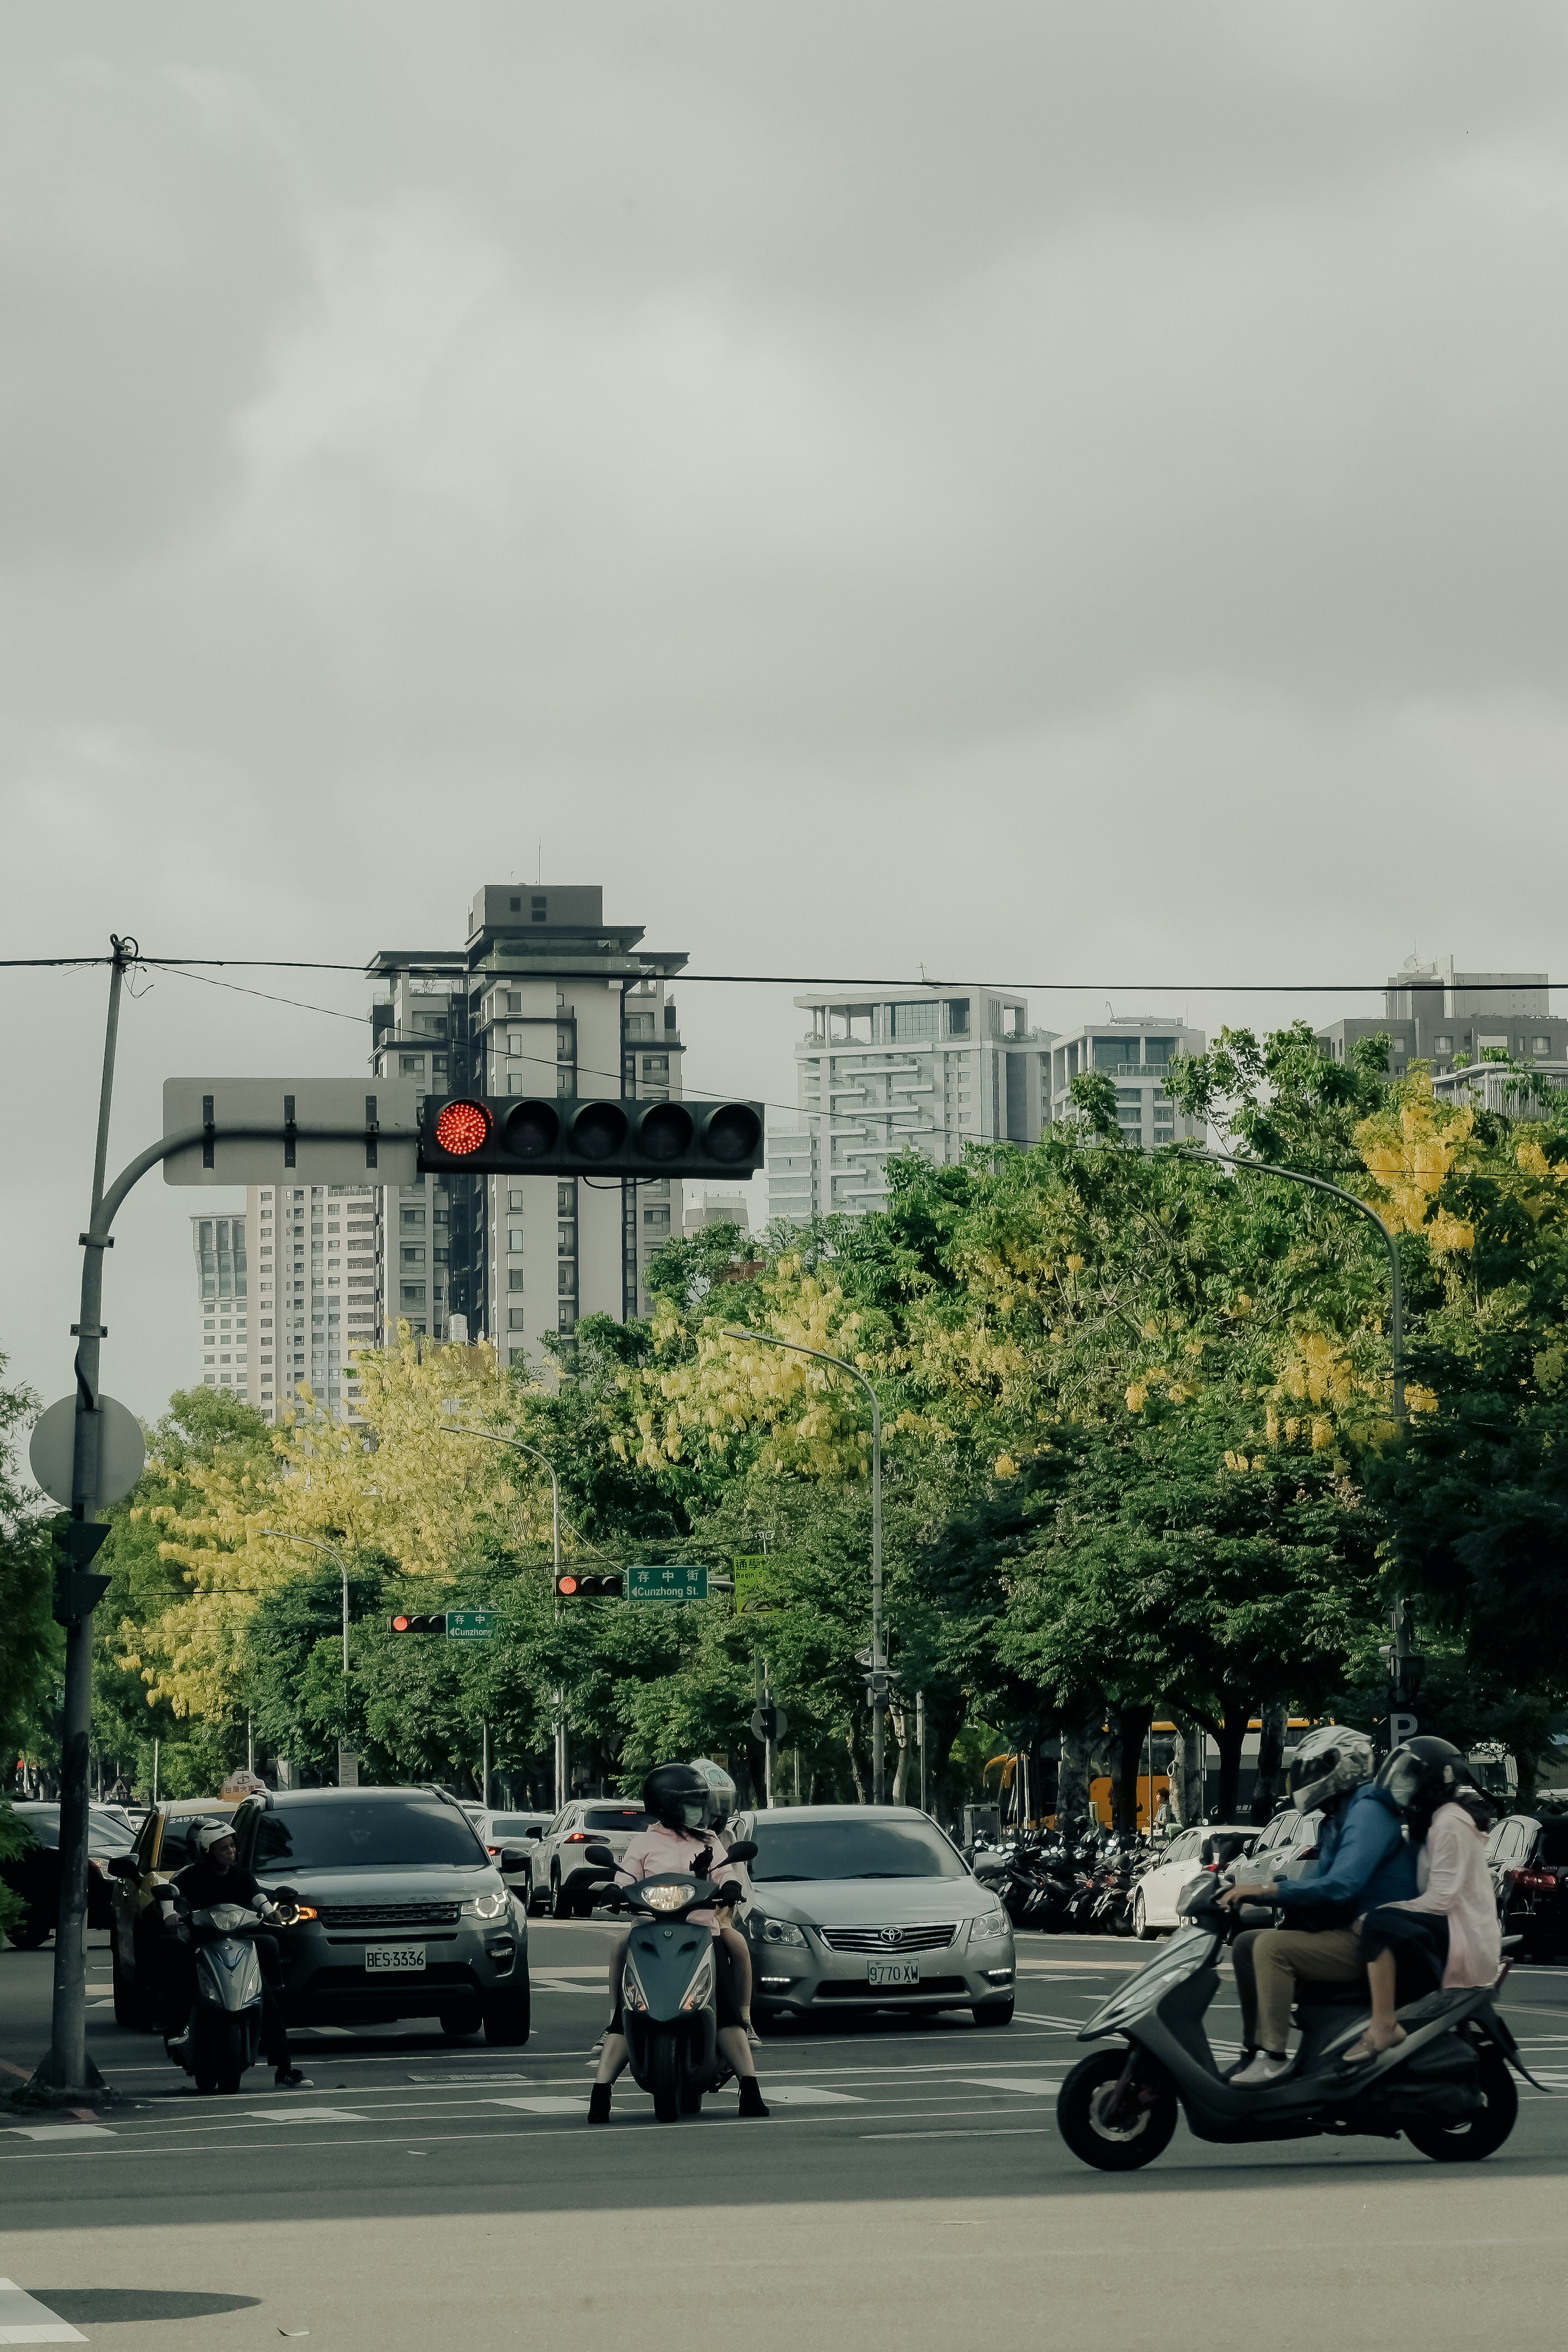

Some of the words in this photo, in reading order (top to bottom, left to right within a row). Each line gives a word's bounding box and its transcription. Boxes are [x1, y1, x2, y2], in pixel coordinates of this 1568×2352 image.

[638, 1569, 699, 1583] 存中街
[638, 1586, 683, 1598] Cunzhong
[686, 1586, 699, 1595] St.
[1390, 1714, 1418, 1750] P
[169, 1815, 204, 1824] 24979
[335, 1895, 442, 1905] DISCOVERY
[366, 1950, 425, 1968] BES-3336
